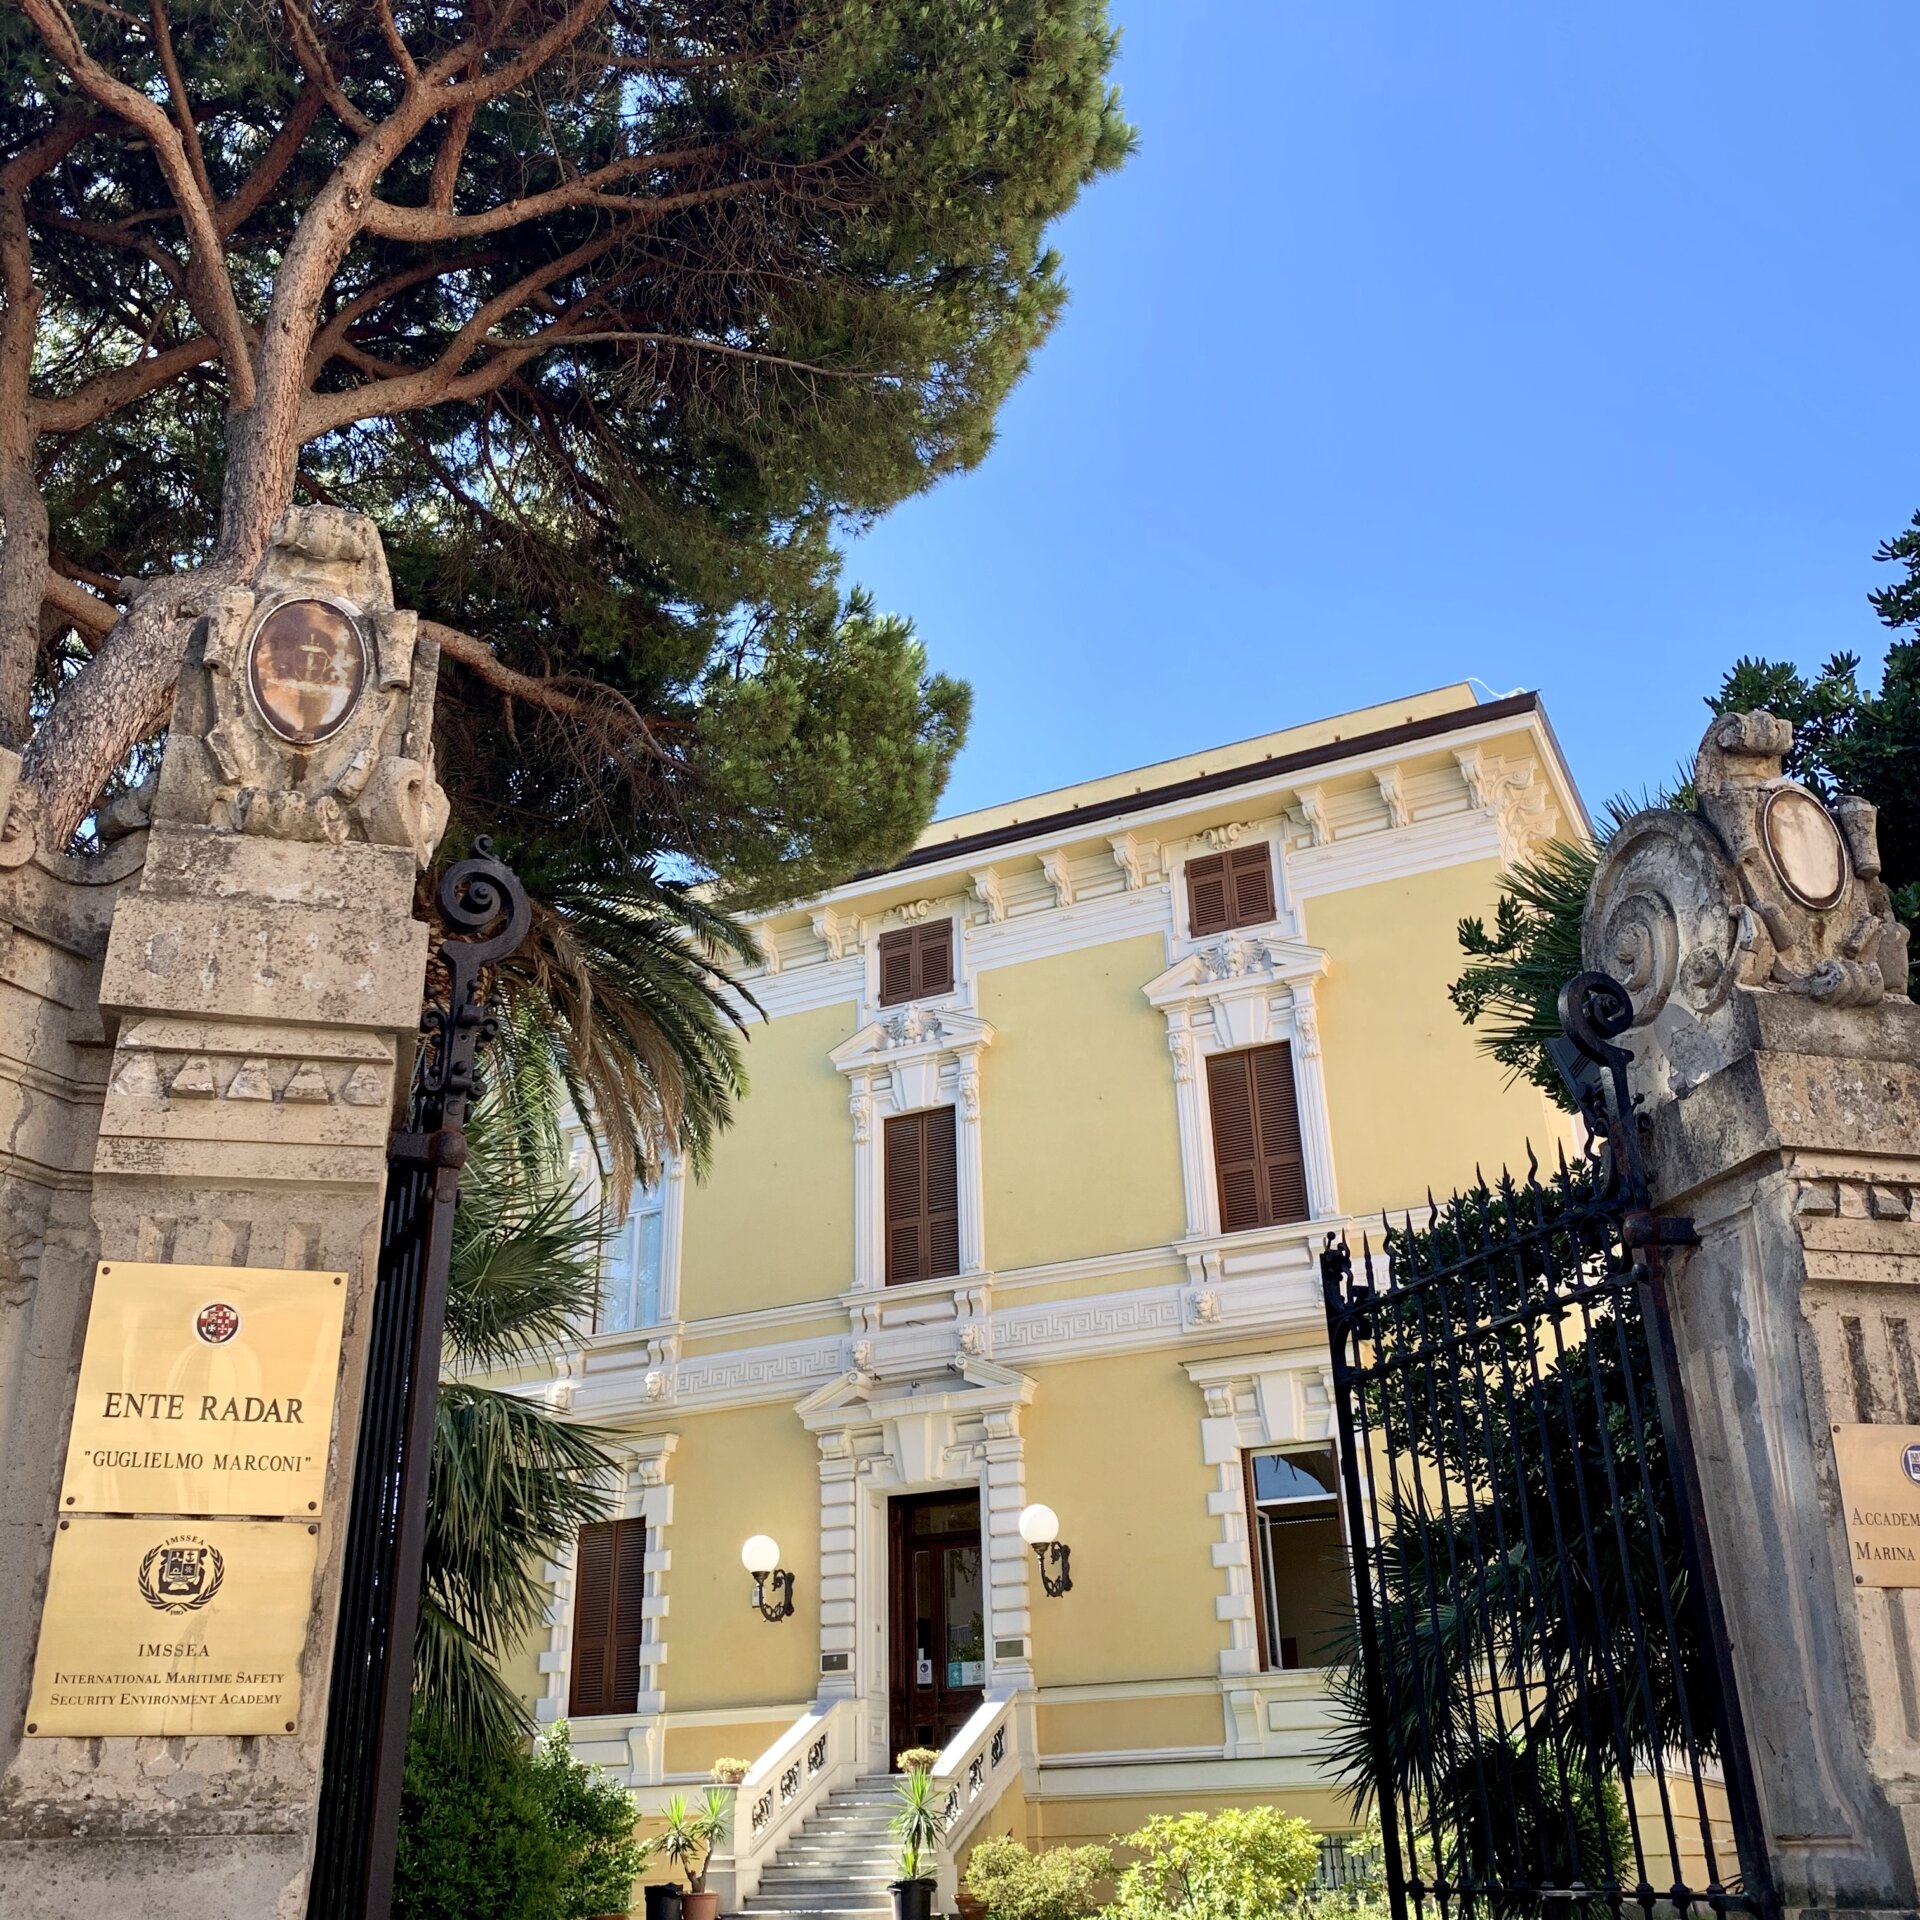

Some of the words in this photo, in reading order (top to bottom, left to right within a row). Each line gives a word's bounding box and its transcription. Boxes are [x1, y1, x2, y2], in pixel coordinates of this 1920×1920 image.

[102, 1392, 184, 1420] ENTE
[199, 1396, 304, 1424] RADAR
[166, 1535, 204, 1546] IMSSEA
[1855, 1542, 1916, 1560] MARINA
[138, 1644, 209, 1657] IMSSEA
[54, 1672, 161, 1684] INTERNATIONAL
[165, 1672, 232, 1684] MARITIME
[236, 1672, 284, 1684] SAFETY
[50, 1693, 116, 1706] SECURITY
[120, 1693, 216, 1705] ENVIRONMENT
[220, 1693, 282, 1705] ACADEMY
